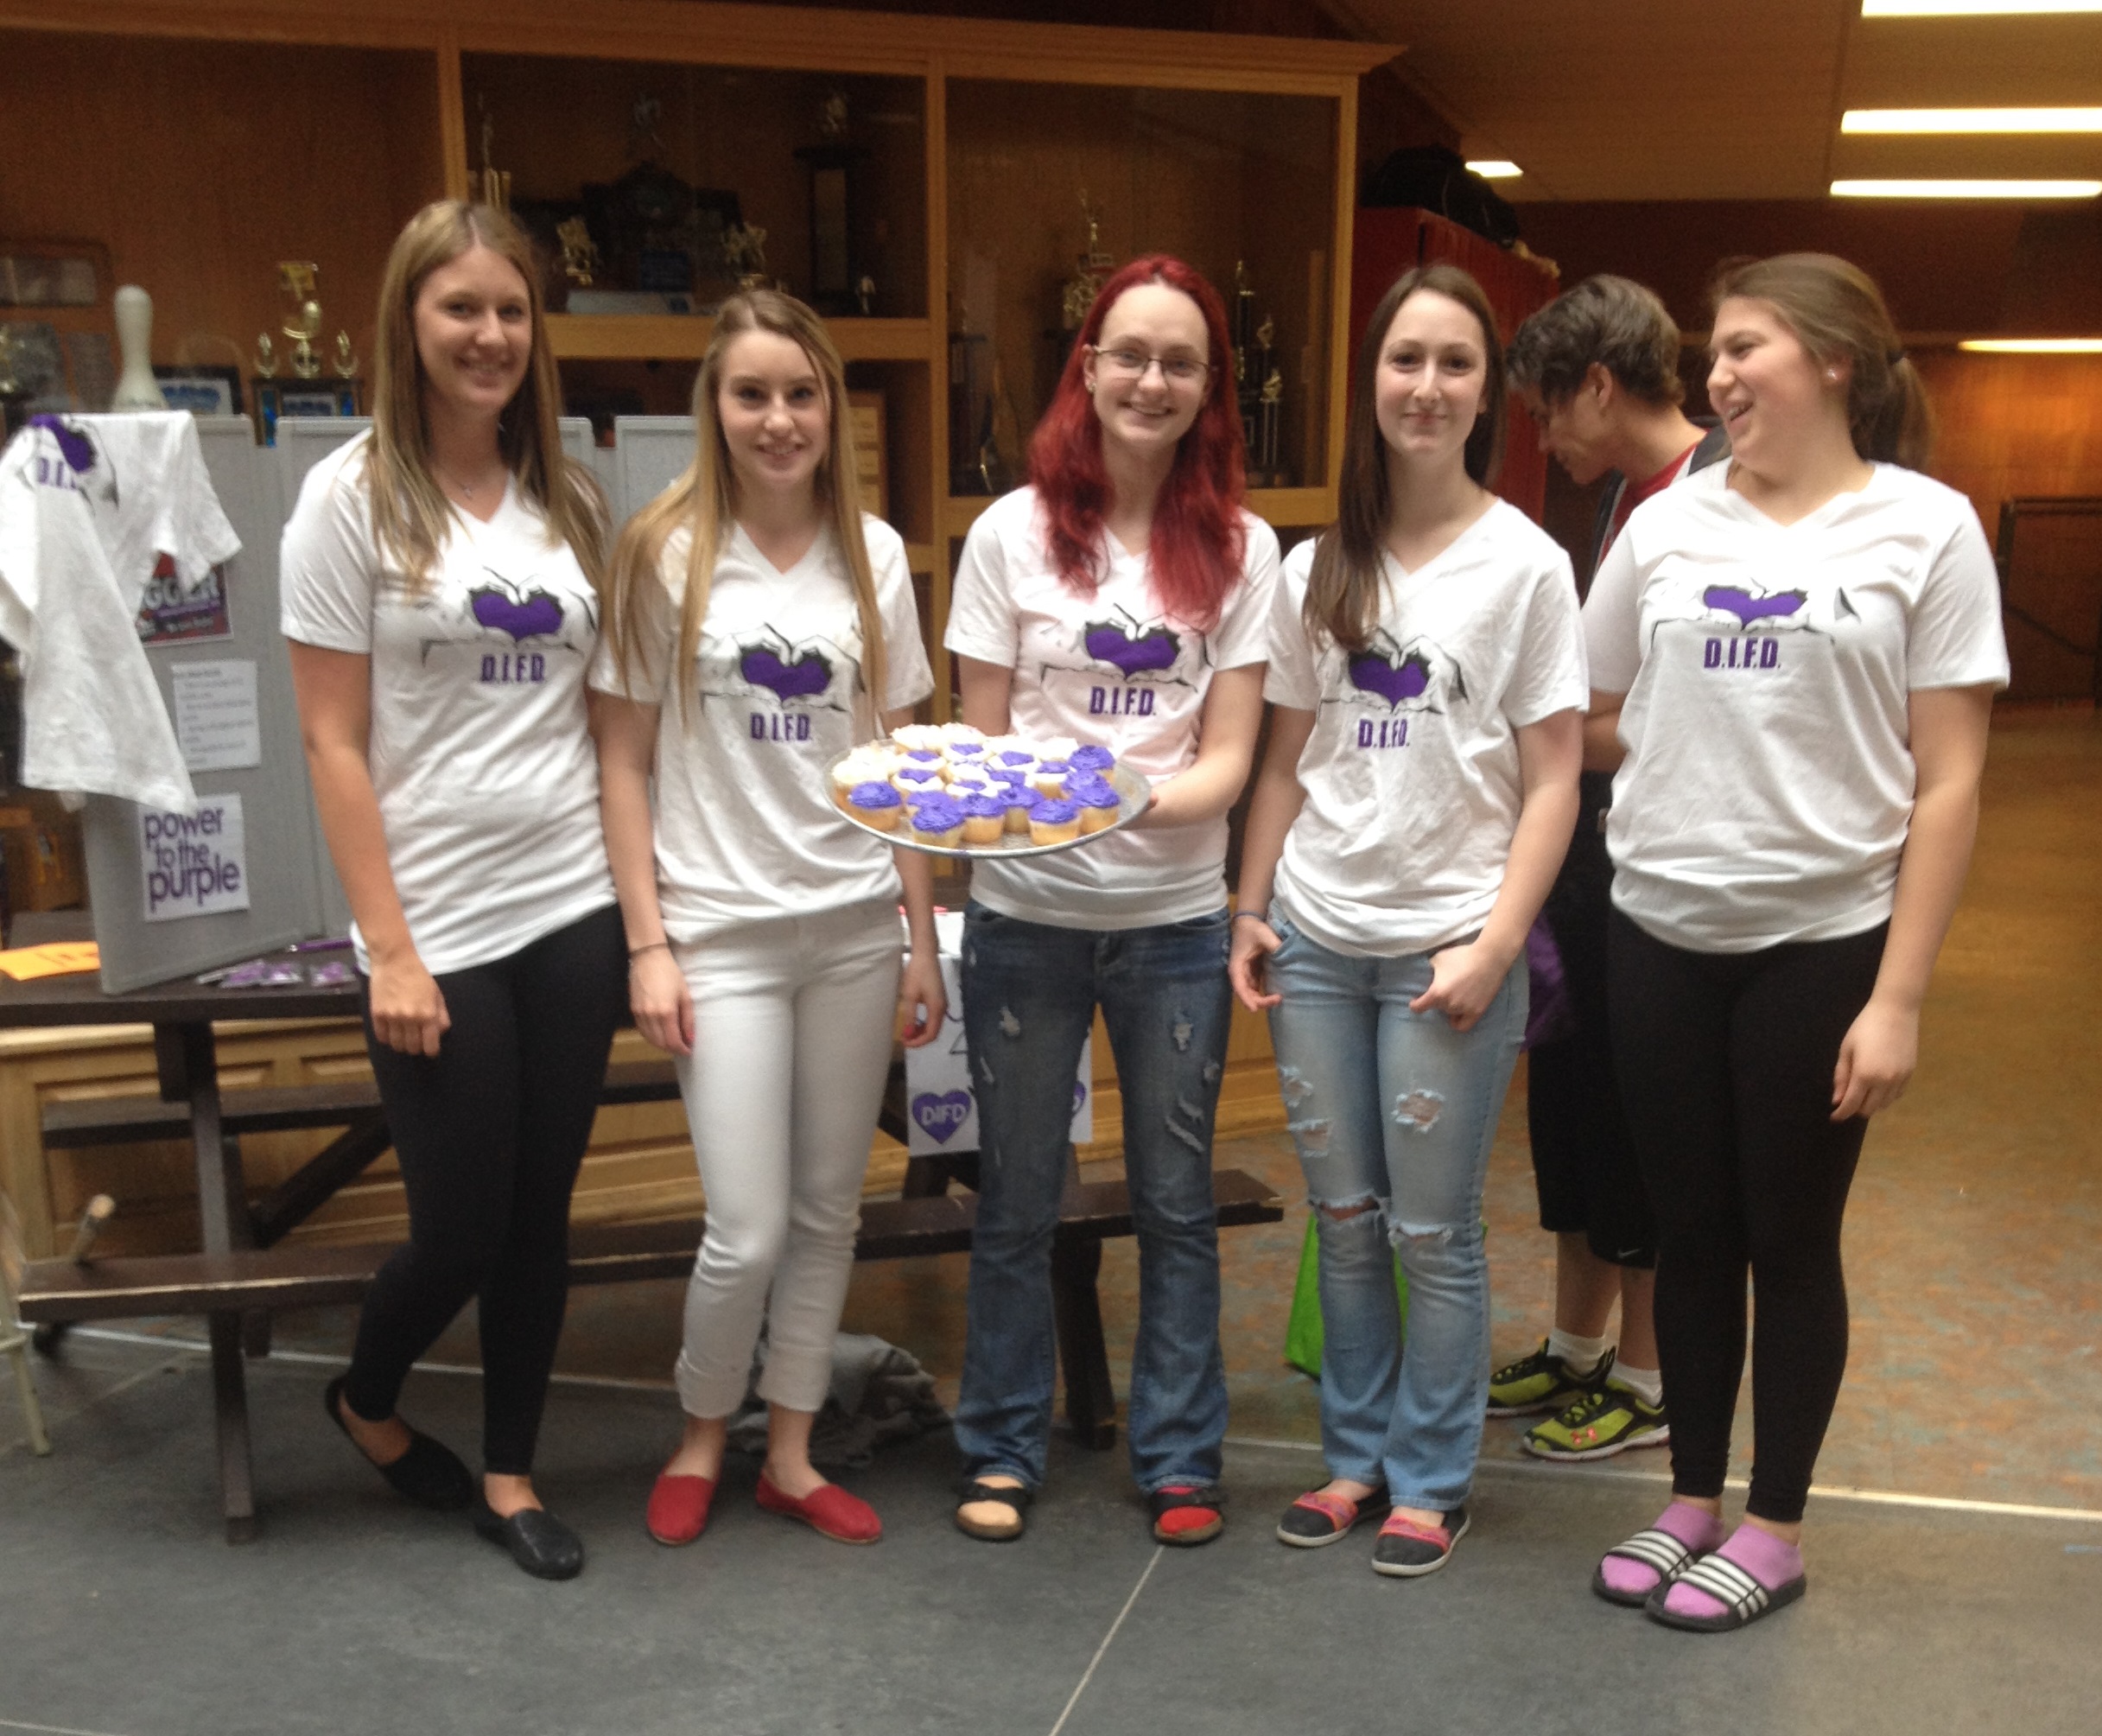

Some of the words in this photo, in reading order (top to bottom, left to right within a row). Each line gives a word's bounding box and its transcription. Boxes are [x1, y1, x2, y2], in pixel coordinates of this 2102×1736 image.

[1703, 637, 1781, 669] D.I.F.D.
[1089, 686, 1157, 716] D.I.F.D.
[1357, 719, 1410, 749] D.I.F.D.
[144, 808, 224, 849] power
[156, 842, 175, 869] to
[178, 838, 209, 866] the
[148, 853, 240, 913] purple
[921, 1103, 967, 1126] DIFD
